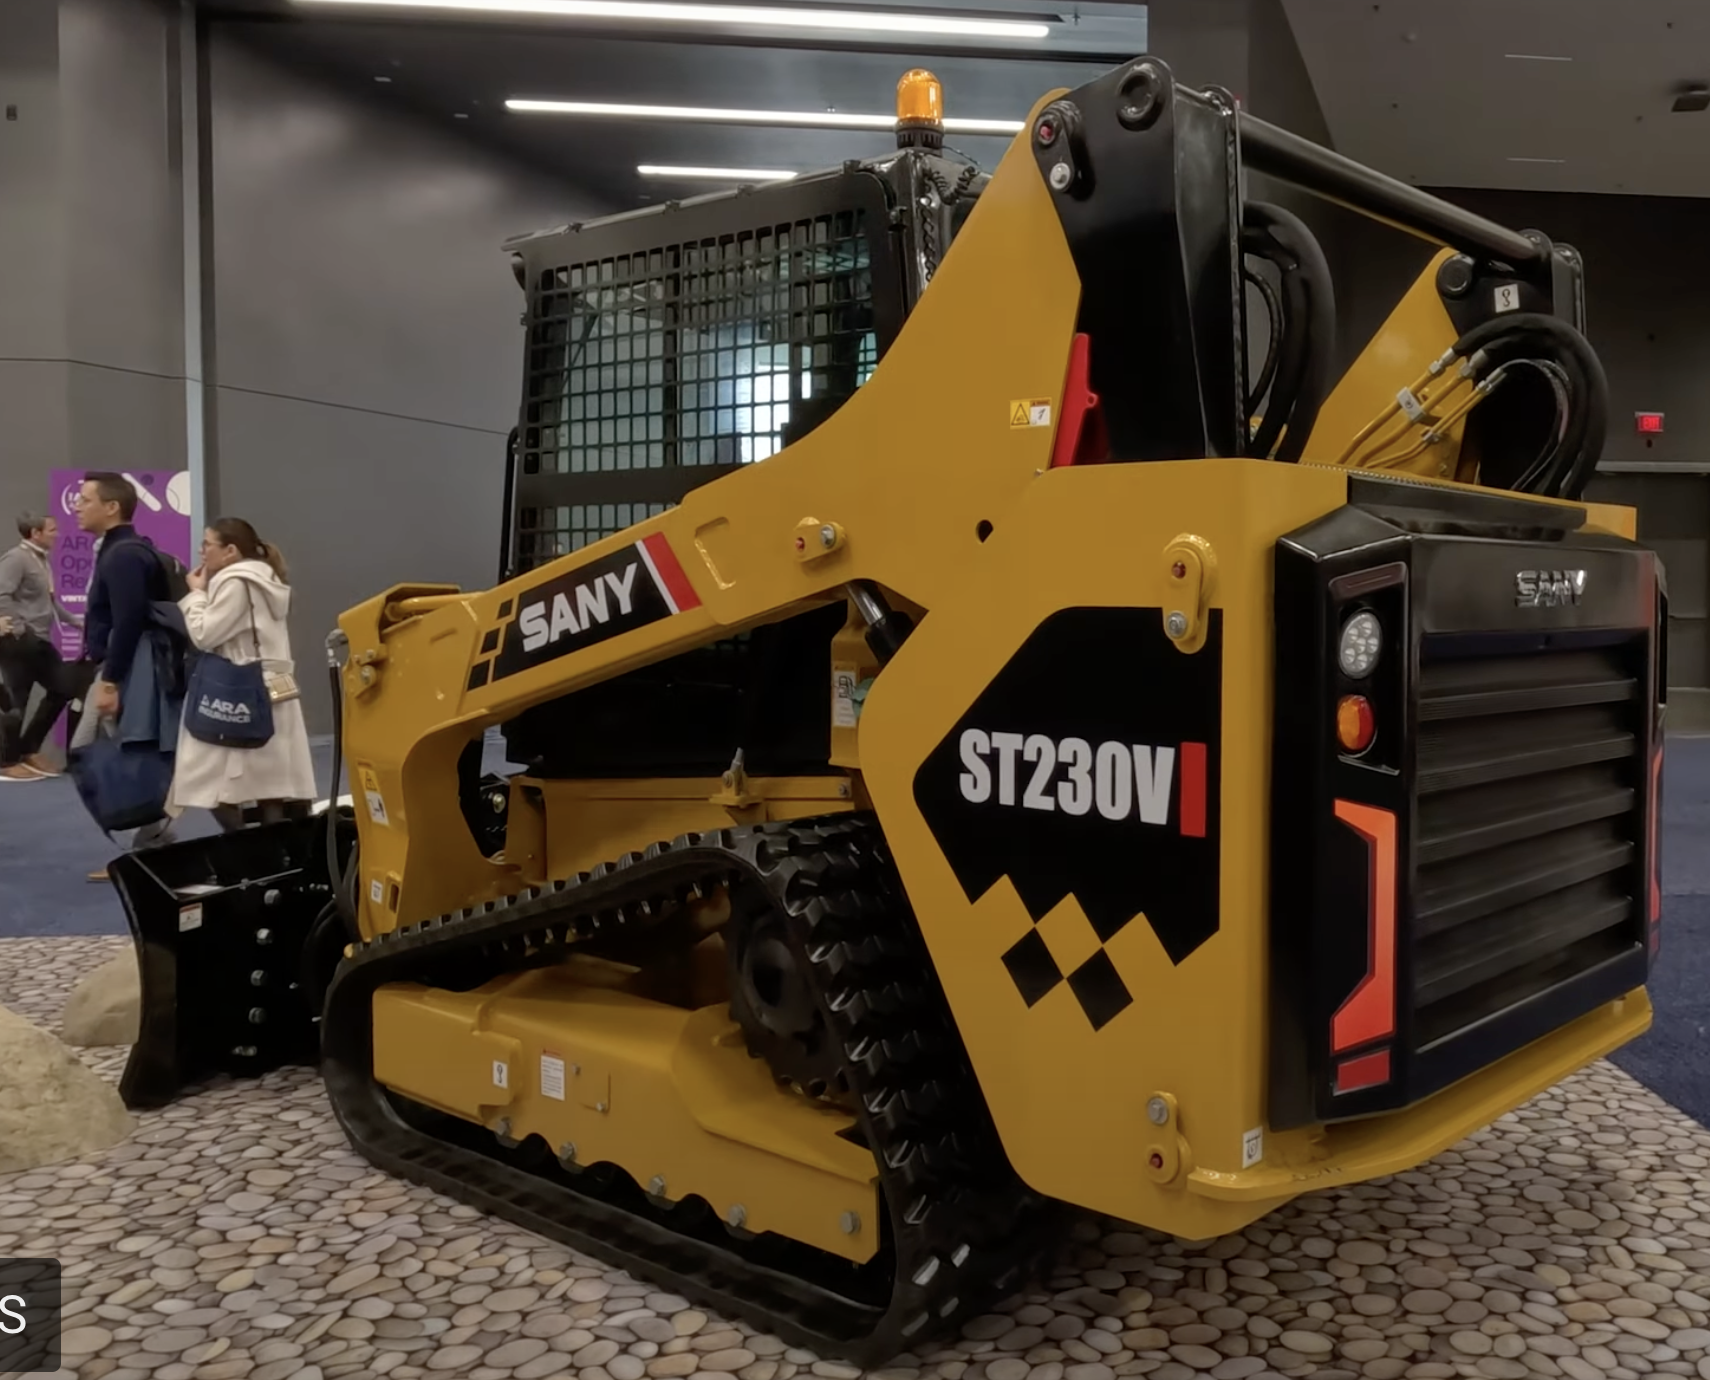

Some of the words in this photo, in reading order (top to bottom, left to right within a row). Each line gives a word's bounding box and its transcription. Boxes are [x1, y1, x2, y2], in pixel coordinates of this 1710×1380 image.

[519, 562, 638, 652] SANY
[1515, 569, 1588, 608] SANY
[211, 698, 251, 715] ARA
[959, 728, 1175, 825] ST230V
